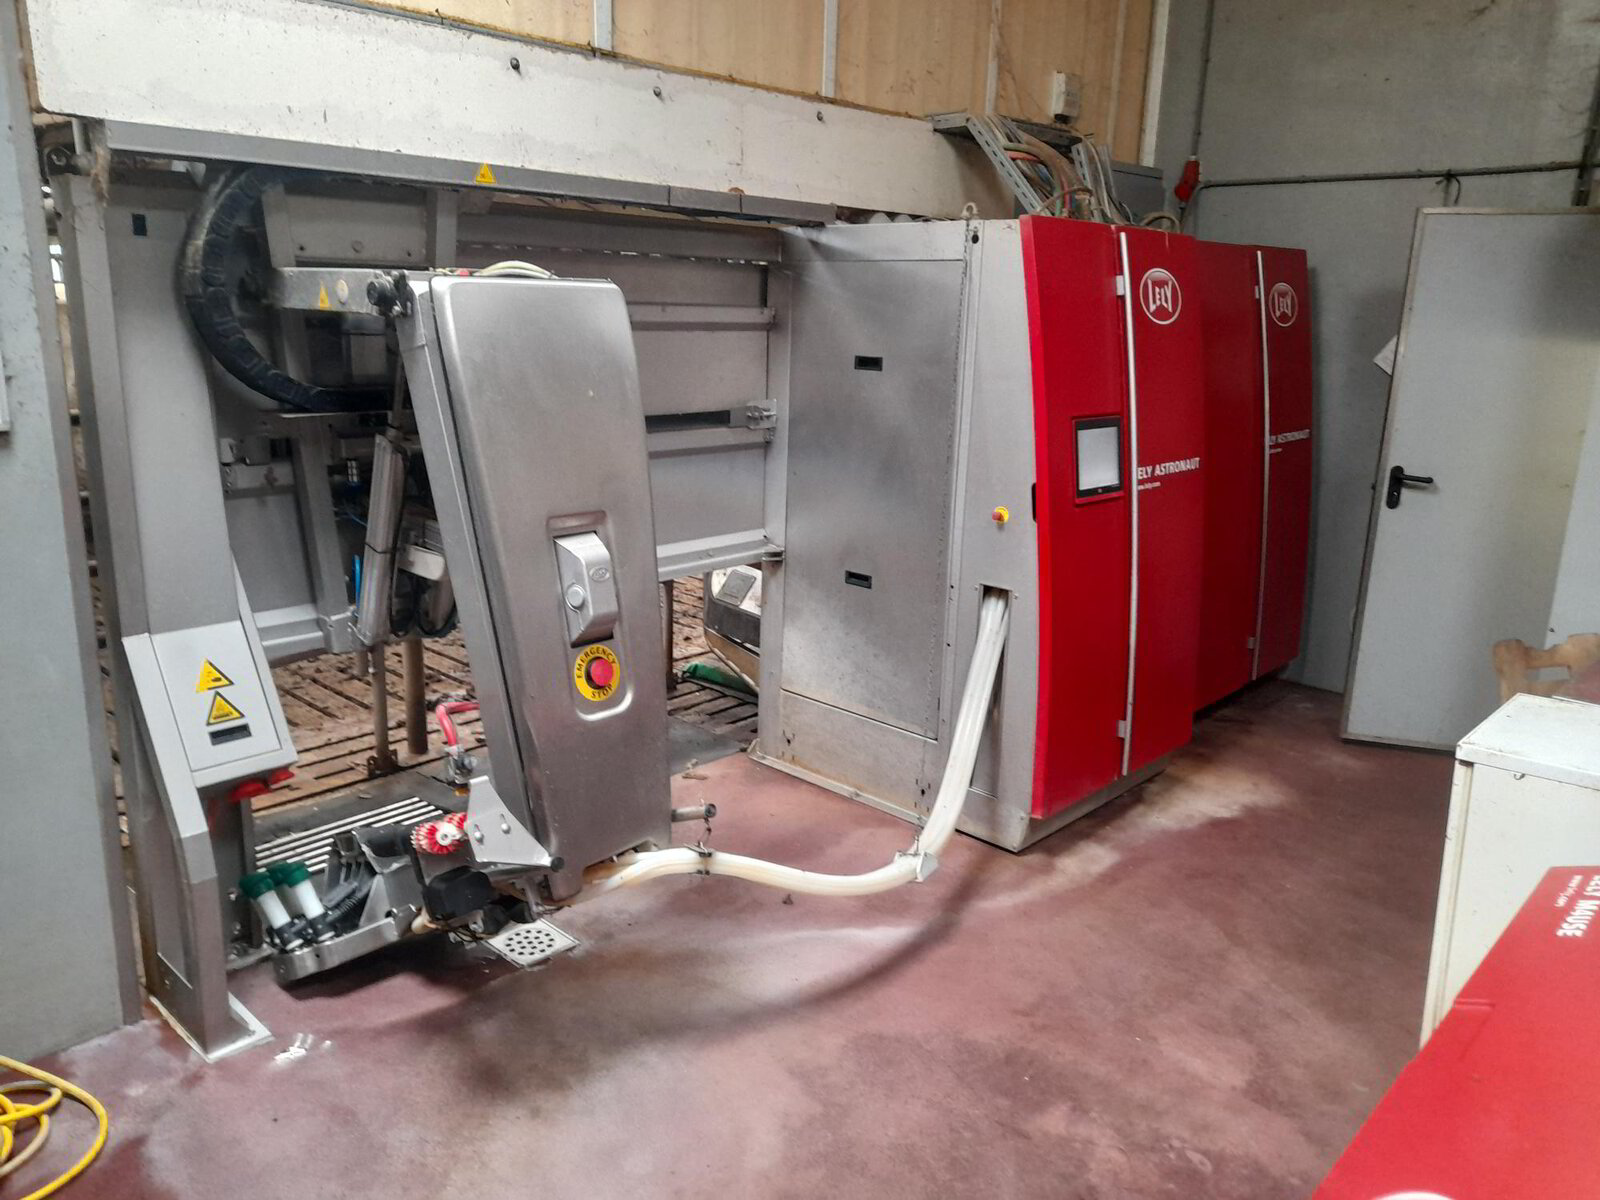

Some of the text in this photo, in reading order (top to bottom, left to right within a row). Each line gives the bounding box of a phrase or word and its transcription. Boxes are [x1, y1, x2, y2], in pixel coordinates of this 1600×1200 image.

[1147, 278, 1173, 313] LELY
[1273, 290, 1293, 318] LELY
[1137, 457, 1200, 480] ELY ASTRONAUT
[576, 646, 616, 679] EMERGENCY
[591, 683, 613, 699] STOP
